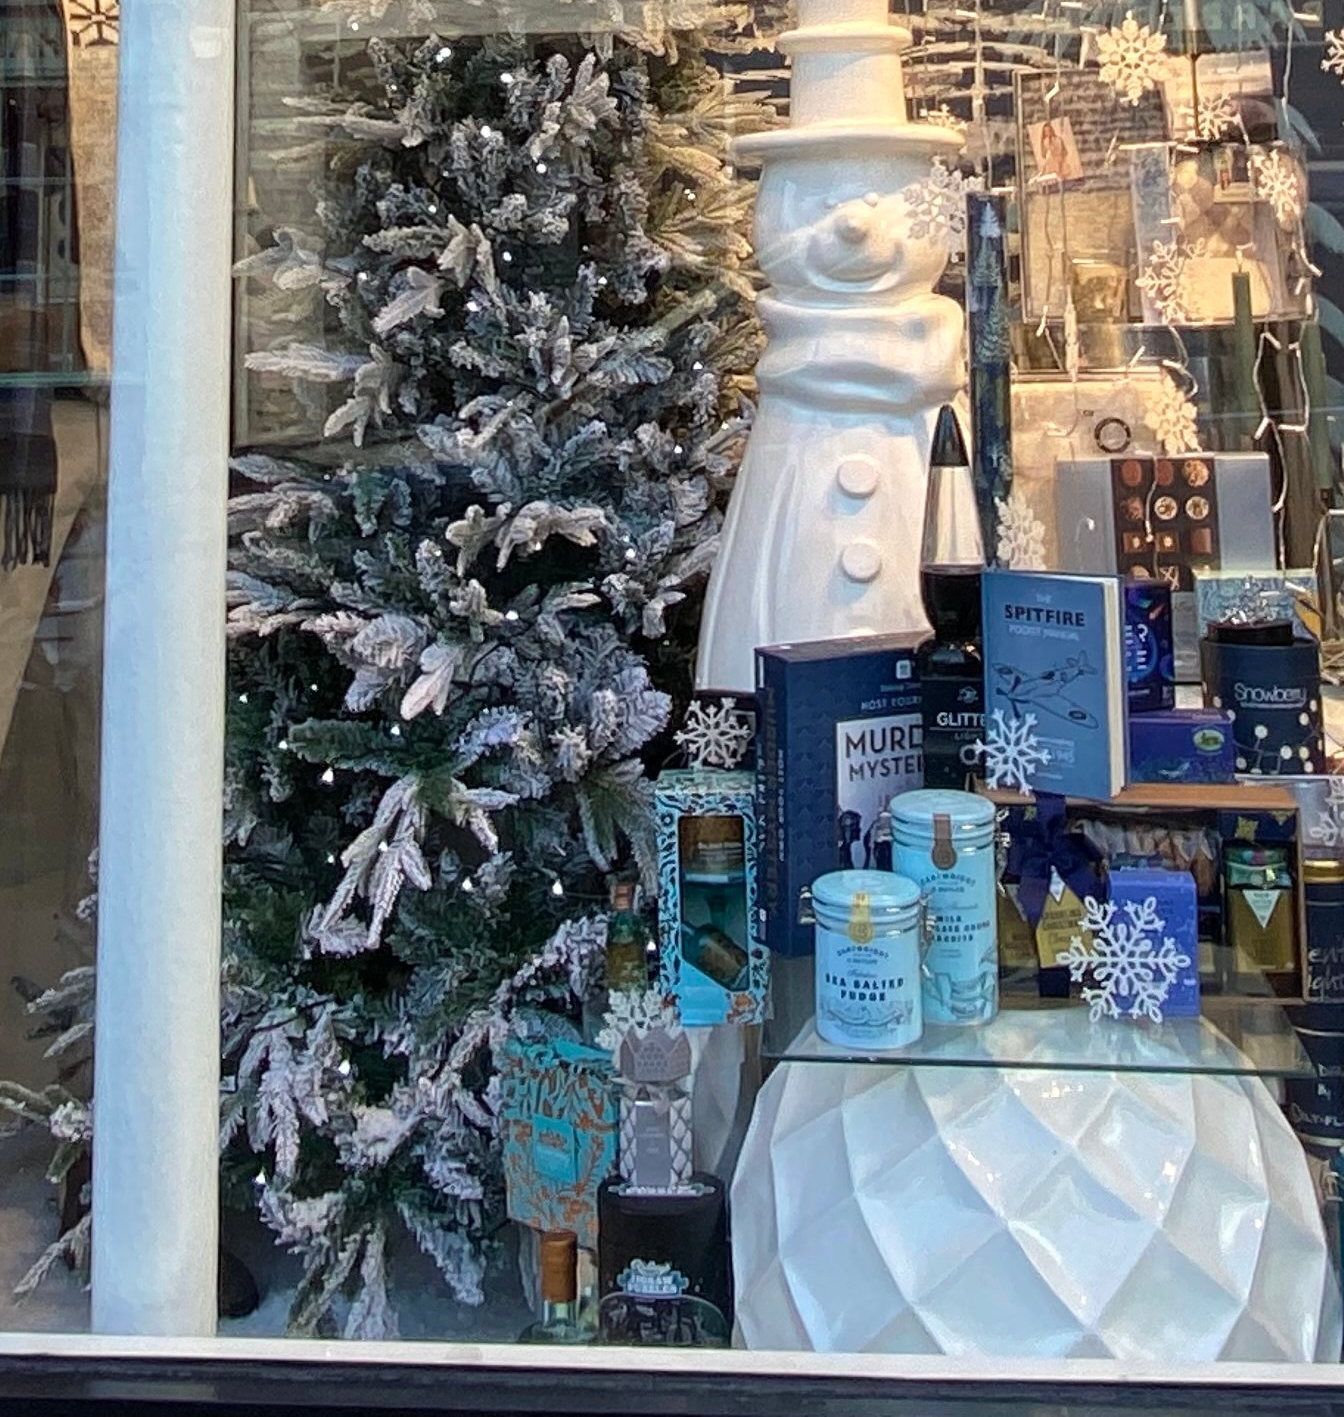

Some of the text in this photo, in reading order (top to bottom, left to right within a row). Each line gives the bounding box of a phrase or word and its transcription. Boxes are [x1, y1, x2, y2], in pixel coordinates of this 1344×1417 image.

[1004, 603, 1085, 627] SPITFIRE
[825, 973, 904, 990] SEA SALTED
[840, 989, 885, 1002] FUDGE
